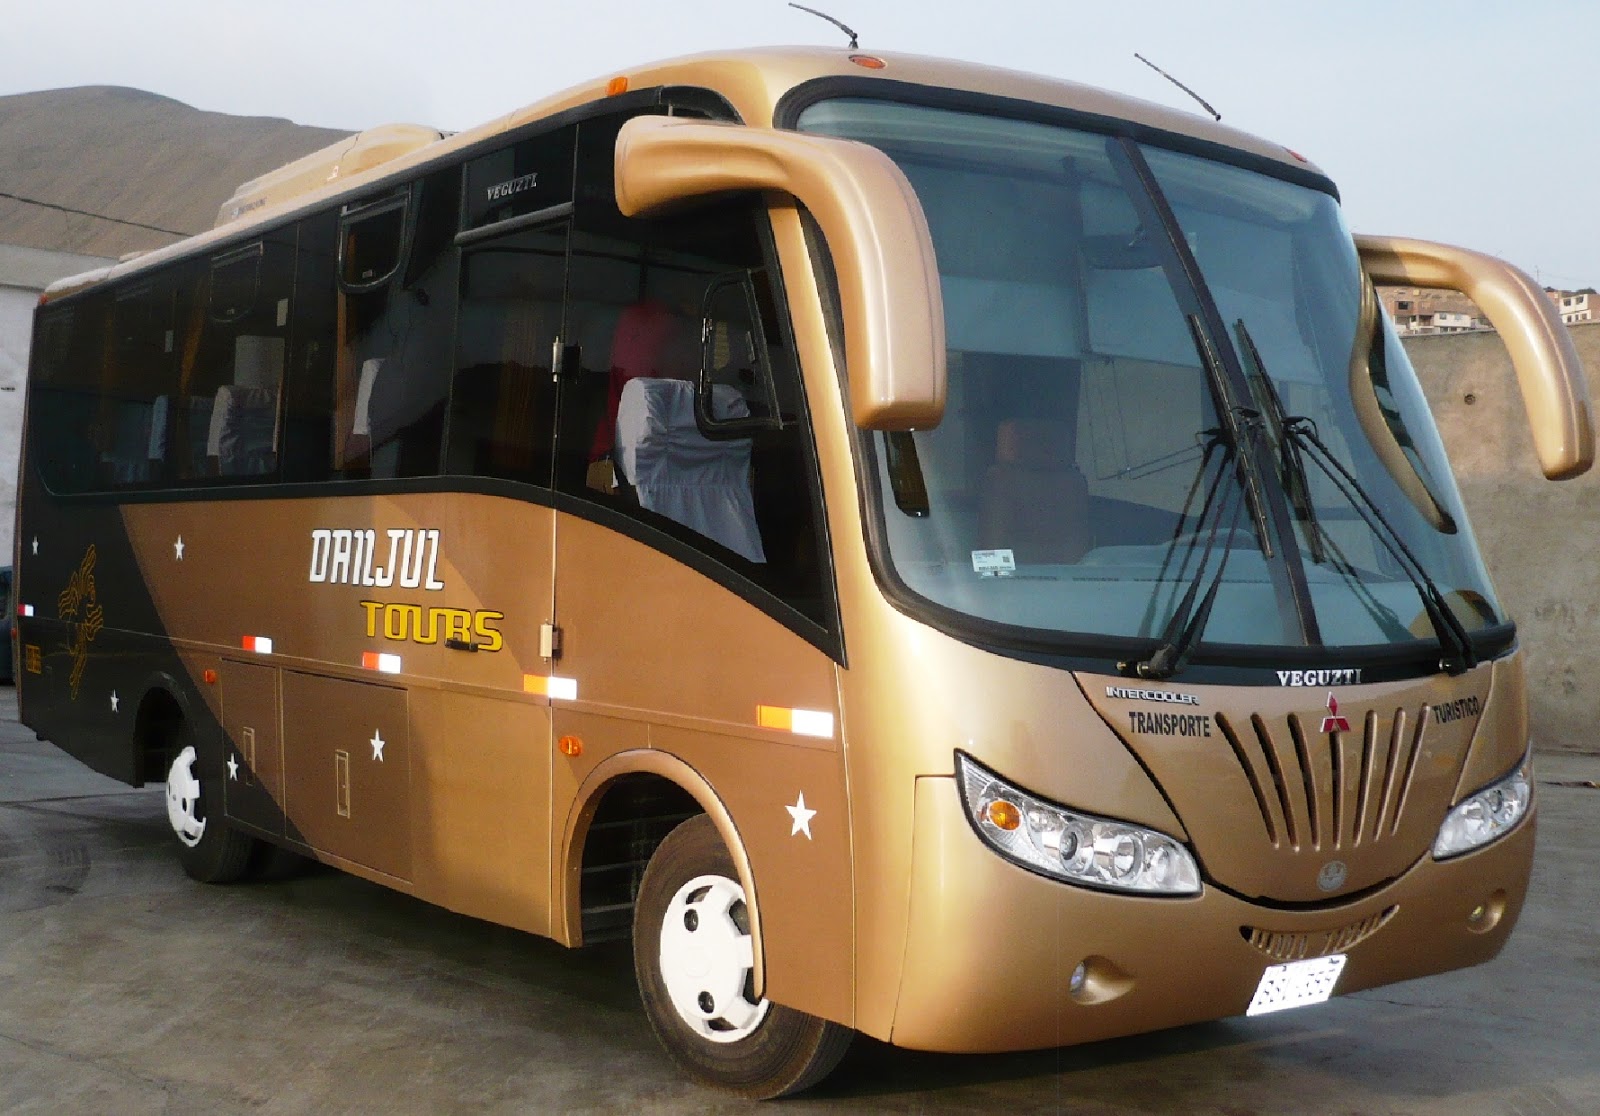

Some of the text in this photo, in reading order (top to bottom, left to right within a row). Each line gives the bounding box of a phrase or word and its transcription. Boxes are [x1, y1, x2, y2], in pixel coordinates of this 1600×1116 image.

[360, 600, 504, 652] TOURS
[1276, 668, 1362, 687] VEGUZTI
[1105, 686, 1200, 706] INTERCOOLER
[1432, 695, 1478, 724] TURISTICO
[1129, 711, 1212, 738] TRANSPORTE
